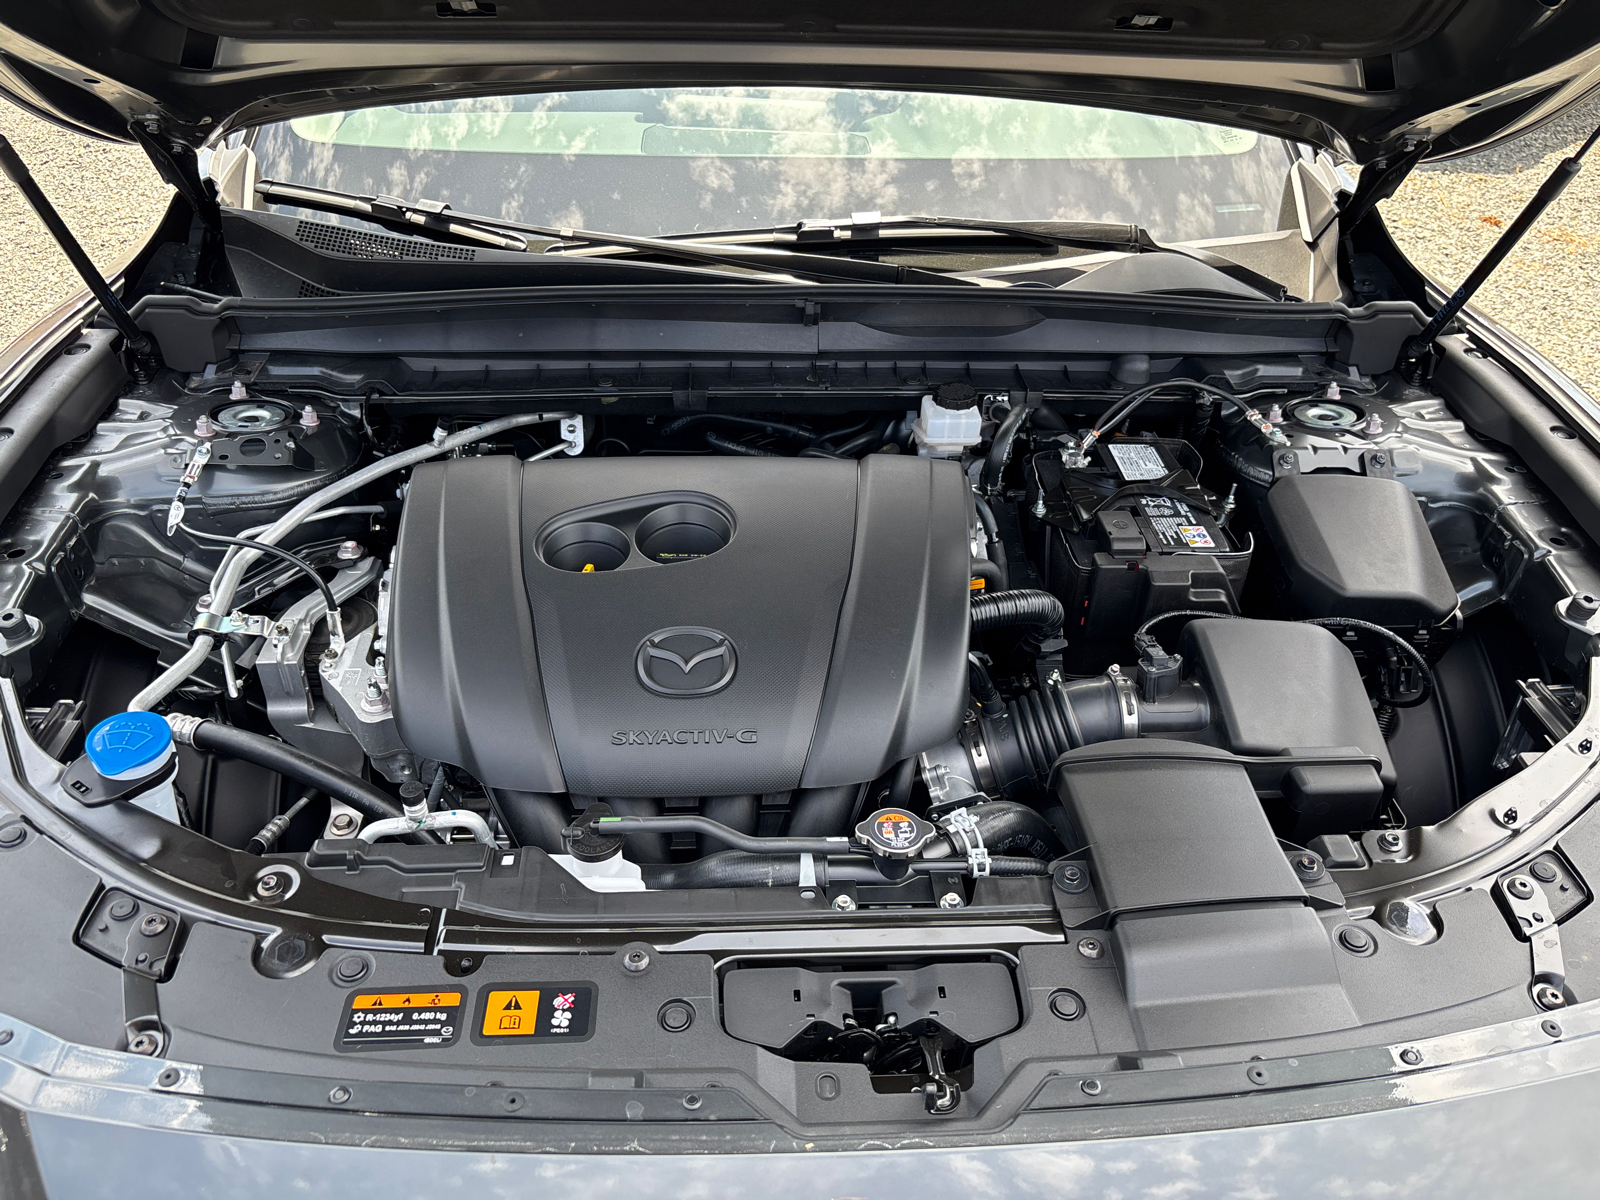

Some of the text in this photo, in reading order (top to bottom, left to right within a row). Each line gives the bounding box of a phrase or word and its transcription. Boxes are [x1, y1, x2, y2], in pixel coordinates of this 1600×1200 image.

[611, 728, 758, 746] SKYACTIV-G
[365, 1012, 403, 1023] R-1234yf
[435, 1011, 447, 1021] kg
[362, 1024, 382, 1033] PAG
